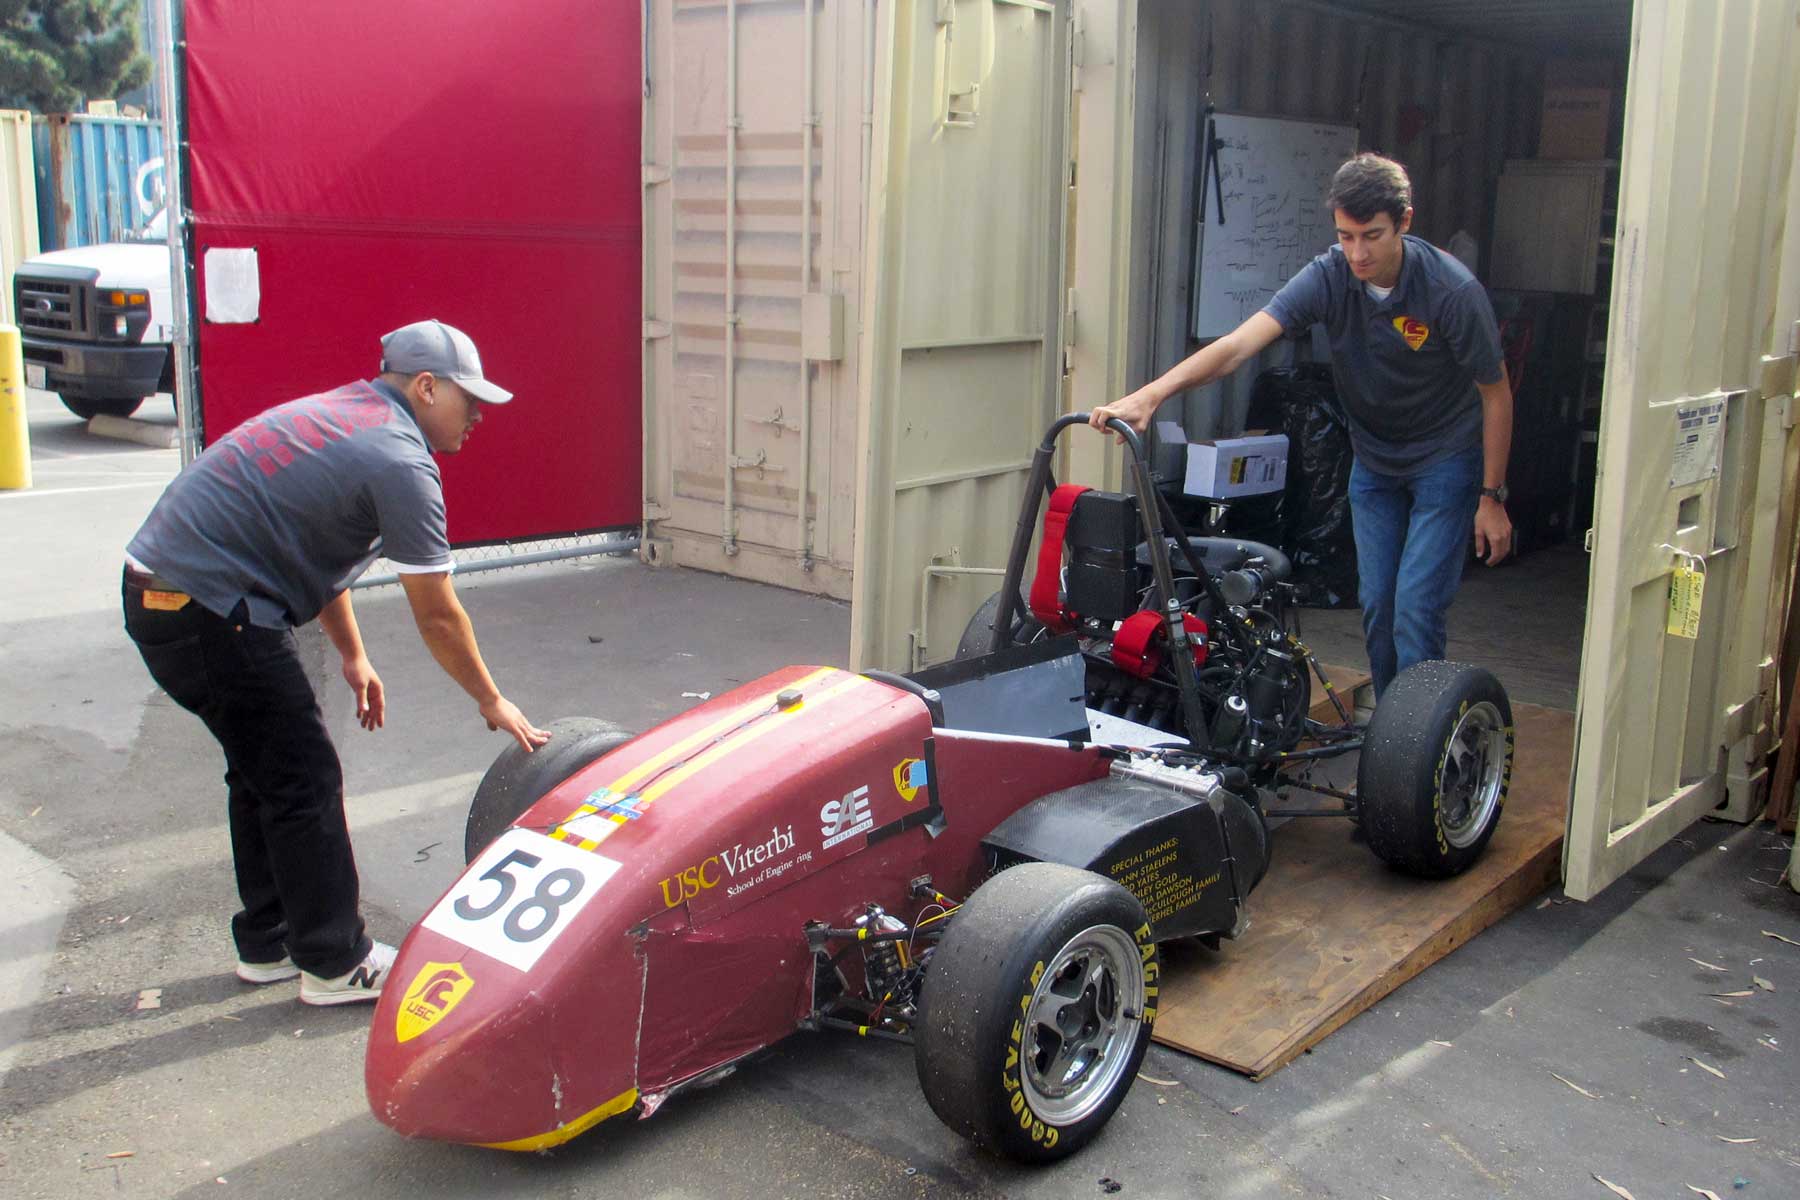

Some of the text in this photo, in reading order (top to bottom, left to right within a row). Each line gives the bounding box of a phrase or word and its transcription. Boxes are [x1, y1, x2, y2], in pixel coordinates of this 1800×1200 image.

[820, 784, 872, 837] SAE
[658, 824, 796, 909] USC Viterbi
[1110, 852, 1143, 875] SPECIAL
[727, 877, 755, 898] School
[755, 870, 765, 883] of
[1155, 872, 1178, 889] GOLD
[1156, 875, 1192, 900] DAWSON
[1195, 872, 1221, 891] FAMILY
[454, 848, 586, 944] 58
[1175, 891, 1202, 912] FAMILY
[1134, 922, 1159, 1024] EAGLE
[406, 1001, 435, 1021] USC
[1003, 960, 1059, 1148] GOODYEAR
